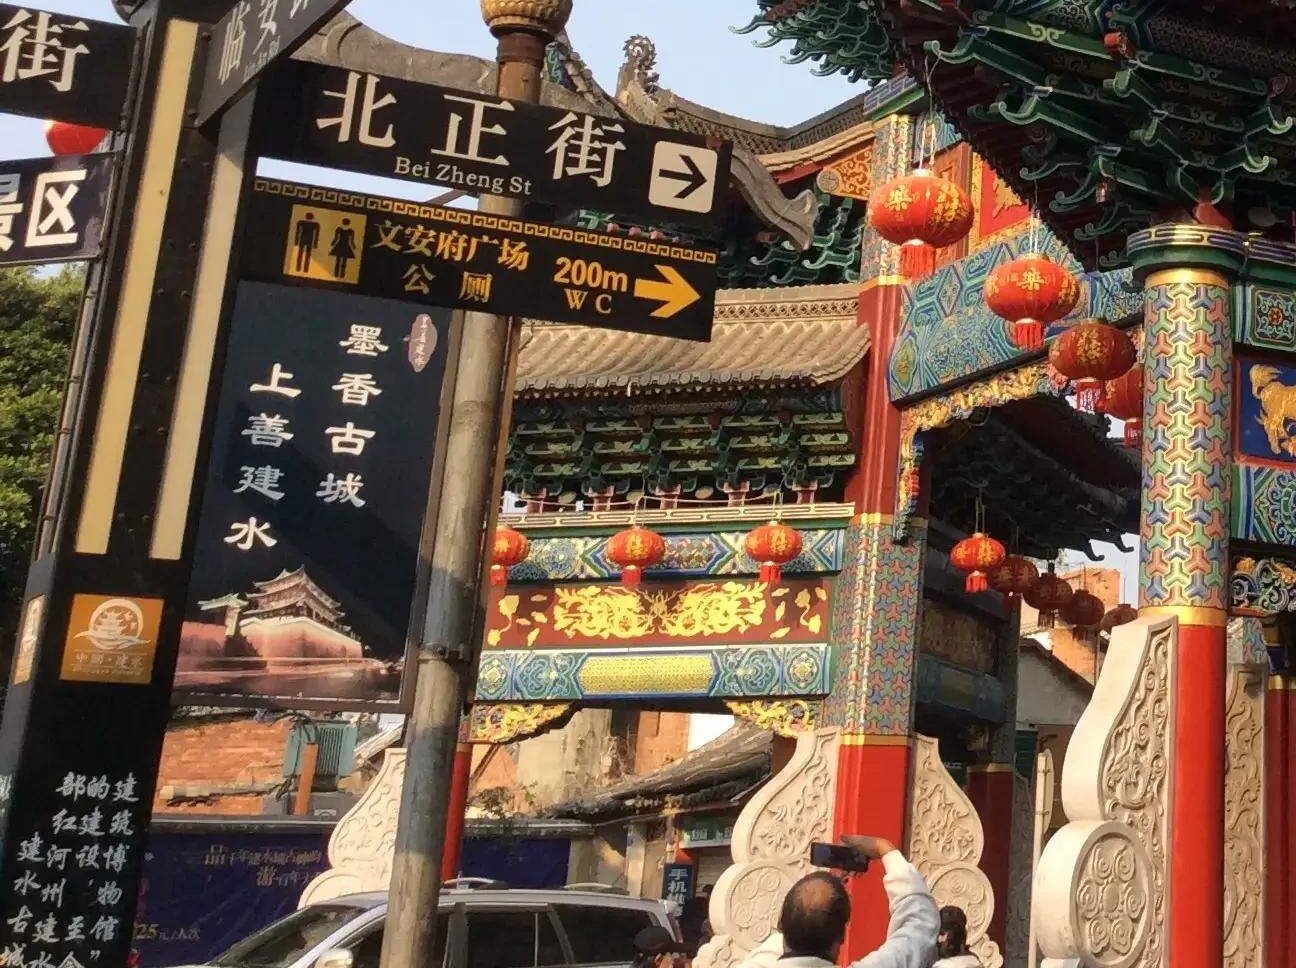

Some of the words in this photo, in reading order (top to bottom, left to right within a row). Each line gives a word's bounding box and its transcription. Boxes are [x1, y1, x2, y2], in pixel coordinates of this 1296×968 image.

[0, 9, 90, 92] 街
[316, 71, 627, 187] 北正街
[394, 156, 430, 179] Bei
[436, 163, 504, 194] Zheng
[510, 177, 532, 195] St
[369, 219, 530, 272] 文安府广场
[553, 256, 628, 293] 200m
[401, 263, 493, 304] 公厕
[315, 324, 390, 508] 墨香古城
[223, 362, 302, 550] 上善建水
